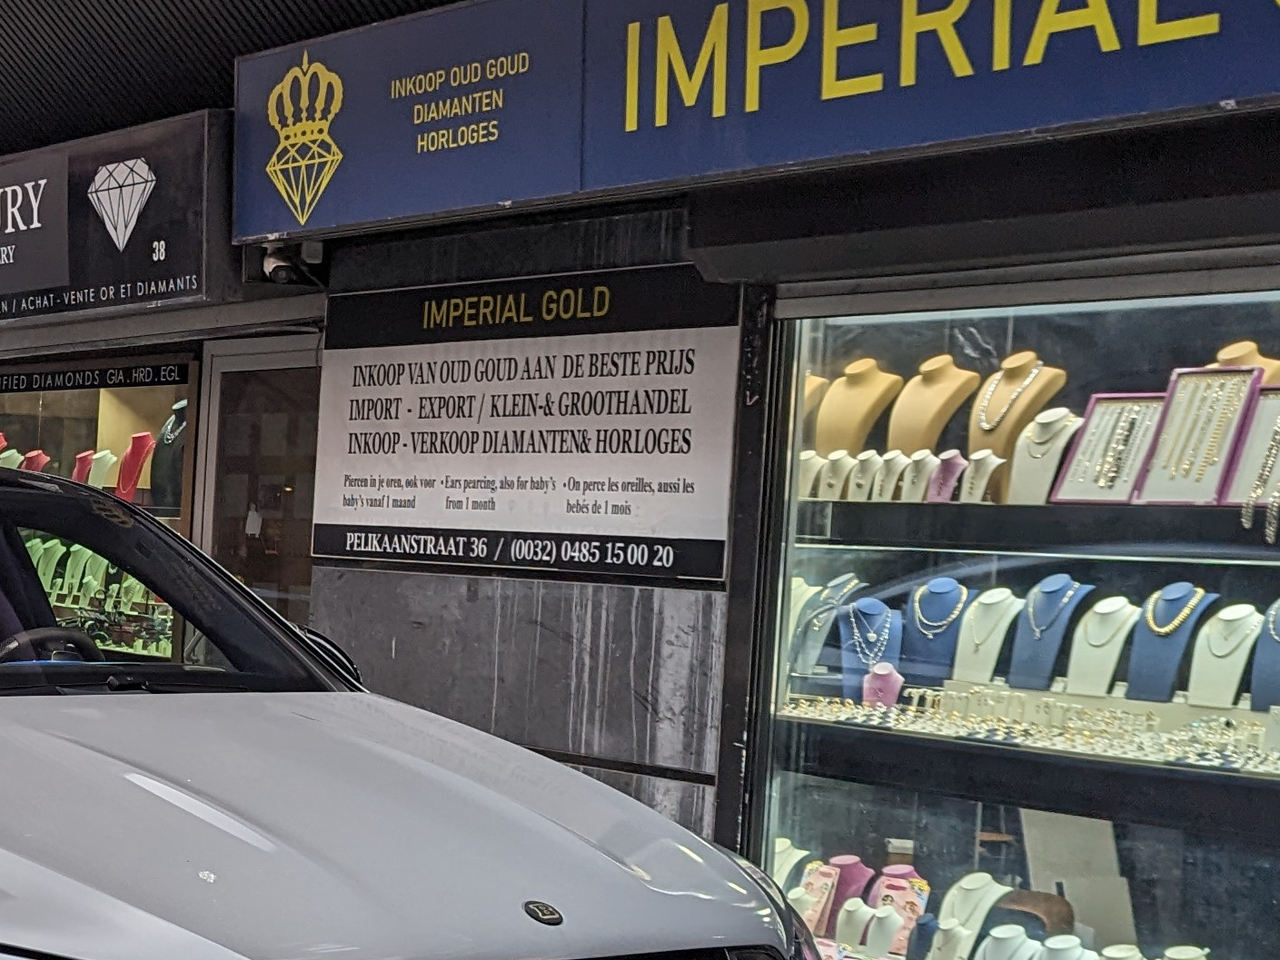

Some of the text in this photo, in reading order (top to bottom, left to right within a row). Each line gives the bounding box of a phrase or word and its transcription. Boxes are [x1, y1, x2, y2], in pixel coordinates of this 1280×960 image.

[390, 52, 530, 99] INKOOP OUD GOUD
[413, 88, 504, 125] DIAMANTEN
[417, 120, 499, 154] HORLOGES
[151, 240, 167, 262] 38
[21, 294, 55, 311] ACHAT
[63, 288, 96, 305] VENTE
[100, 286, 115, 301] OR
[120, 283, 132, 298] ET
[137, 274, 198, 297] DIAMANTS
[423, 286, 610, 329] IMPERIAL GOLD
[32, 370, 100, 389] DIAMONDS
[352, 348, 695, 388] INKOOP VAN OUD GOUD AAN DE BESTE PRIJS
[349, 397, 403, 421] IMPORT
[418, 395, 476, 420] EXPORT
[558, 388, 692, 416] GROOTHANDEL
[348, 431, 401, 454] INKOOP
[411, 430, 480, 454] VERKOOP
[594, 428, 692, 455] HORLOGES
[344, 474, 437, 491] Piercen in je oren, ook voor
[499, 476, 515, 490] also
[516, 476, 528, 490] for
[530, 476, 556, 494] baby's
[582, 479, 605, 495] perce
[607, 477, 619, 492] les
[621, 477, 655, 495] oreilles,
[657, 478, 681, 493] aussi
[682, 478, 695, 493] les
[342, 494, 416, 511] baby's vanaf 1 maand
[445, 496, 496, 511] from 1 month
[591, 500, 602, 514] de
[604, 500, 609, 515] 1
[611, 501, 632, 515] mois
[345, 532, 468, 556] PELIKAANSTRAAT
[470, 537, 488, 557] 36
[511, 538, 557, 564] (0032)
[561, 541, 600, 563] 0485
[605, 542, 624, 564] 15
[627, 543, 648, 565] 00
[652, 545, 674, 568] 20
